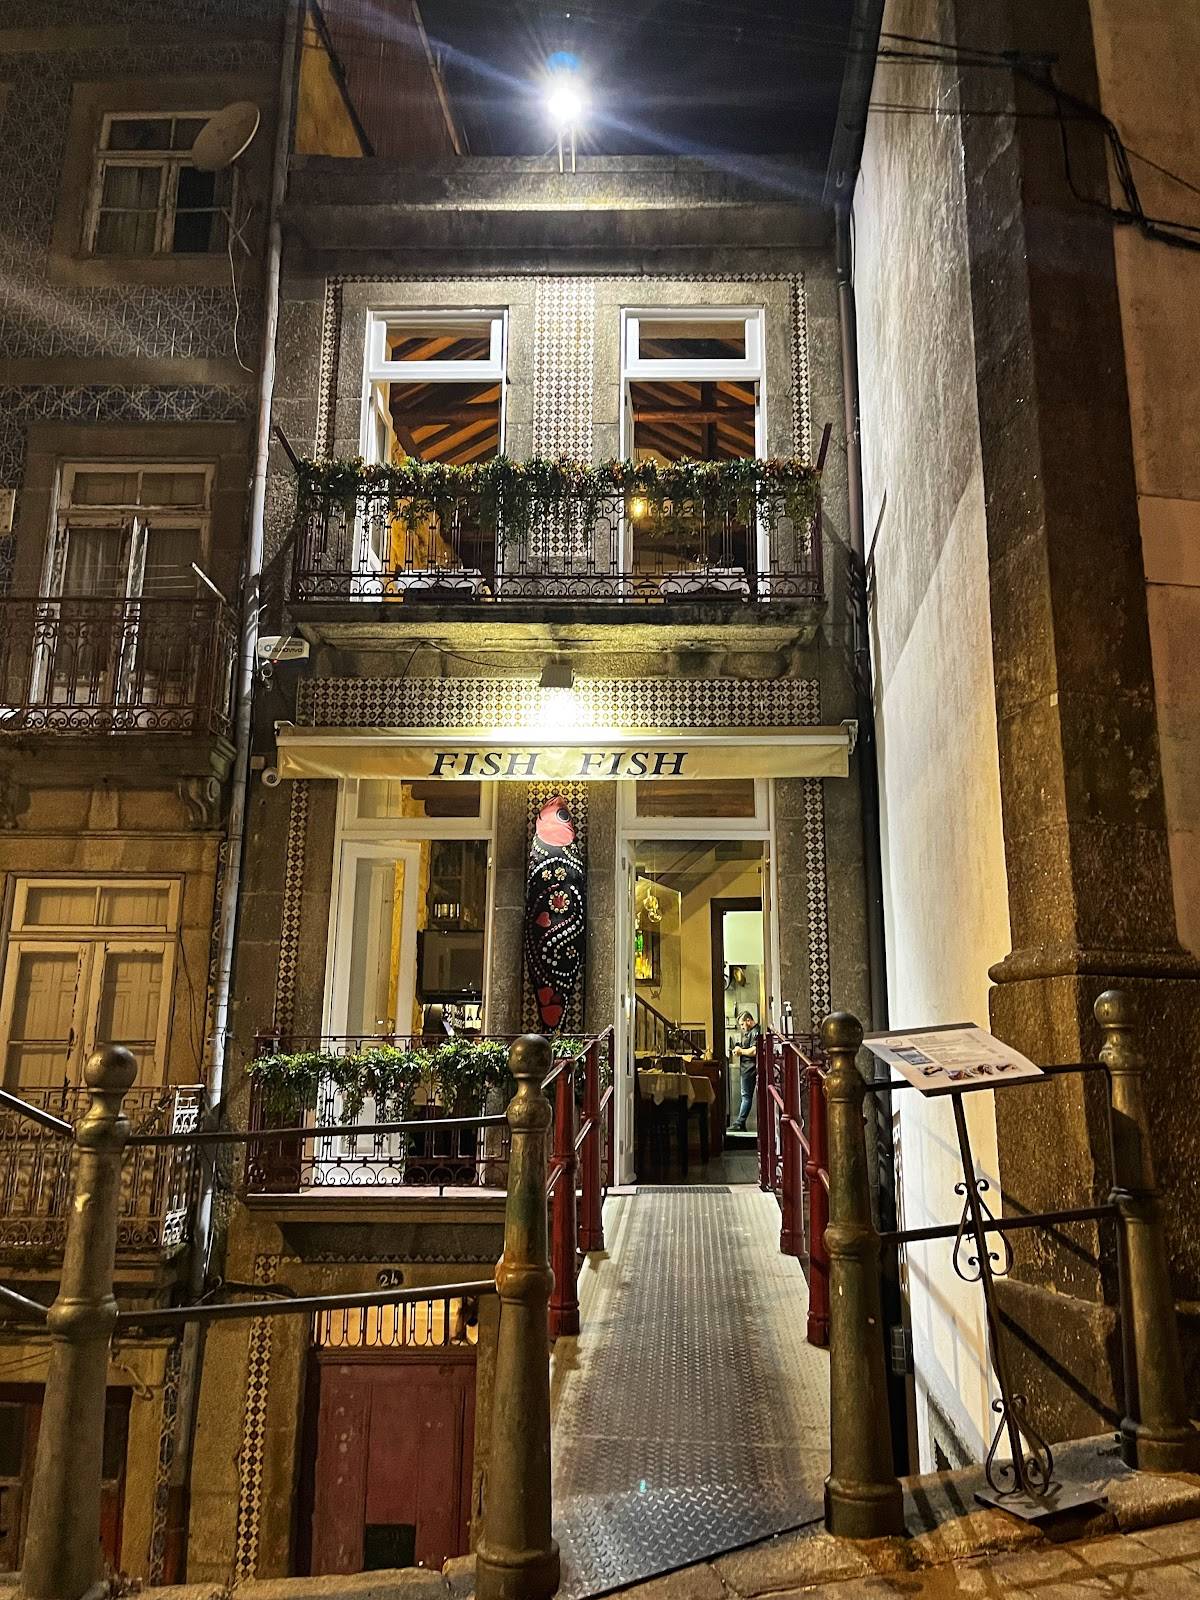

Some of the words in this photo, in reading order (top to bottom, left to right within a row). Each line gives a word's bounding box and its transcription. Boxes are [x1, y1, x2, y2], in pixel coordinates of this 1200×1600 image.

[429, 752, 539, 776] FISH
[578, 752, 688, 776] FISH
[379, 1271, 399, 1287] 24
